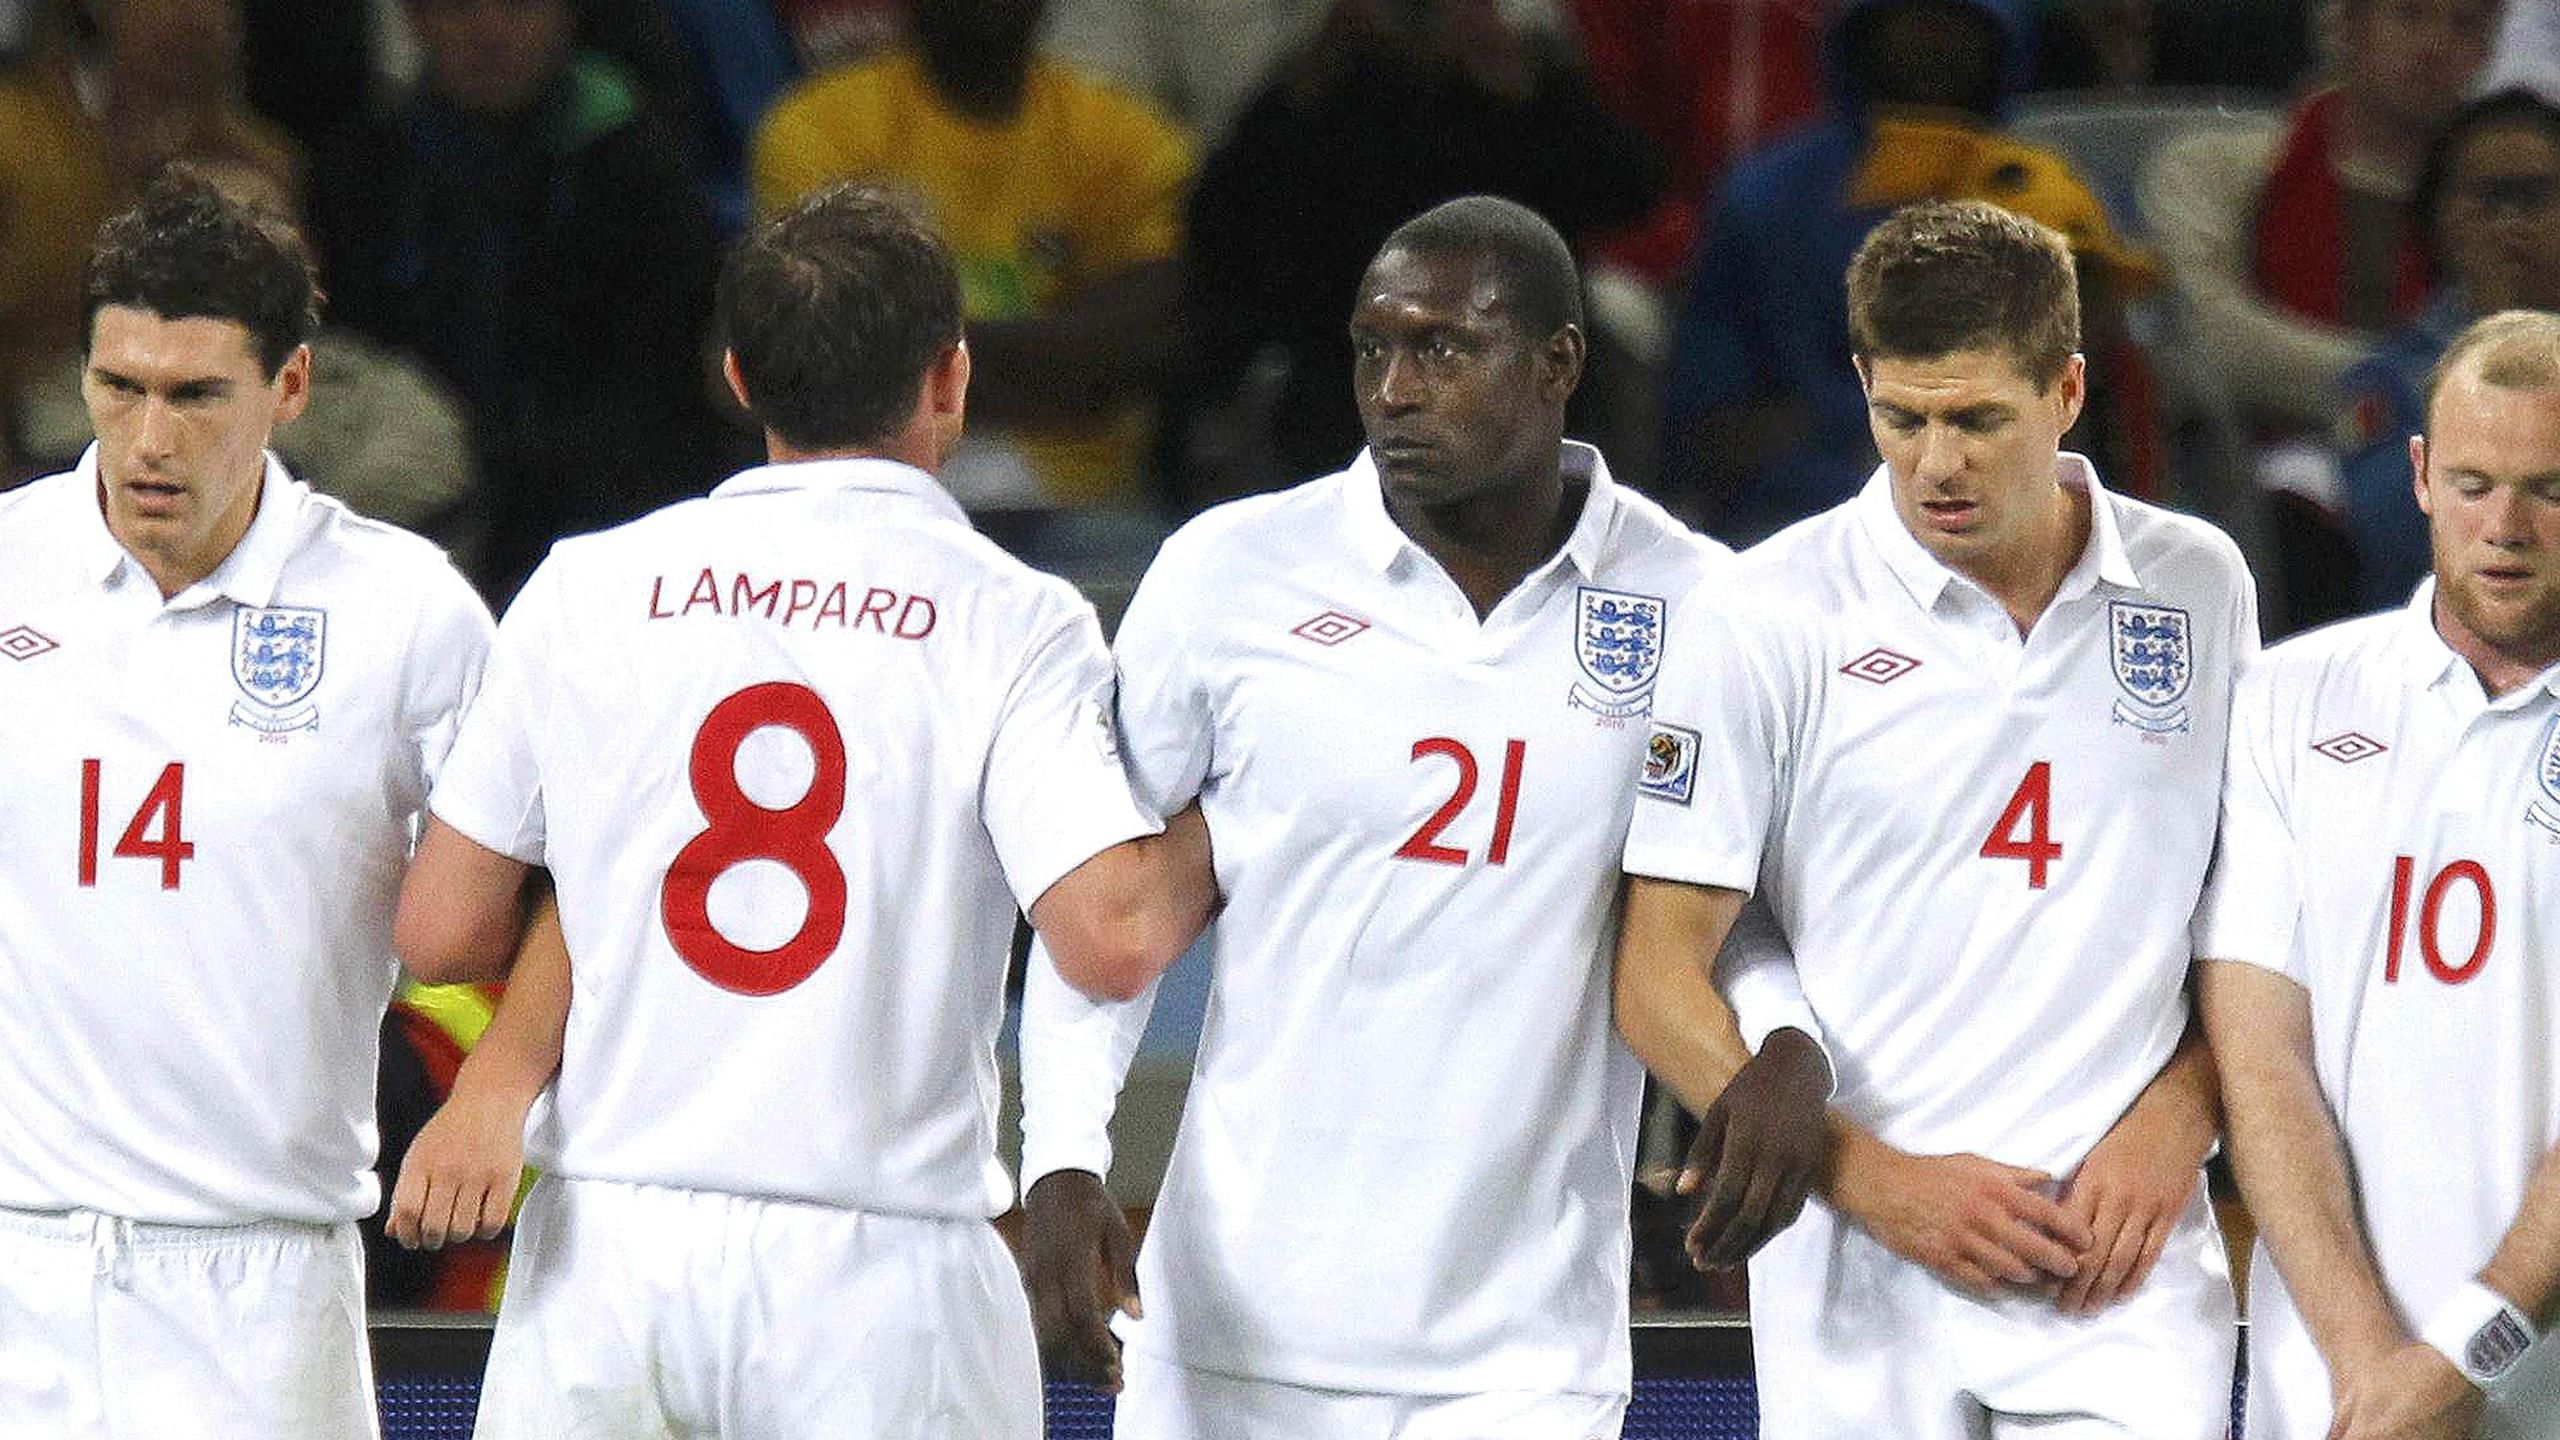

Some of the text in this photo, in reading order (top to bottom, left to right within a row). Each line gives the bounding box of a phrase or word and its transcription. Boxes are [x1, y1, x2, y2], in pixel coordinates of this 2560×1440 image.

[649, 565, 938, 641] LAMPARD
[78, 757, 195, 890] 14
[661, 680, 848, 996] 8
[1396, 735, 1527, 865] 21
[1981, 760, 2063, 889] 4
[2385, 854, 2498, 985] 10
